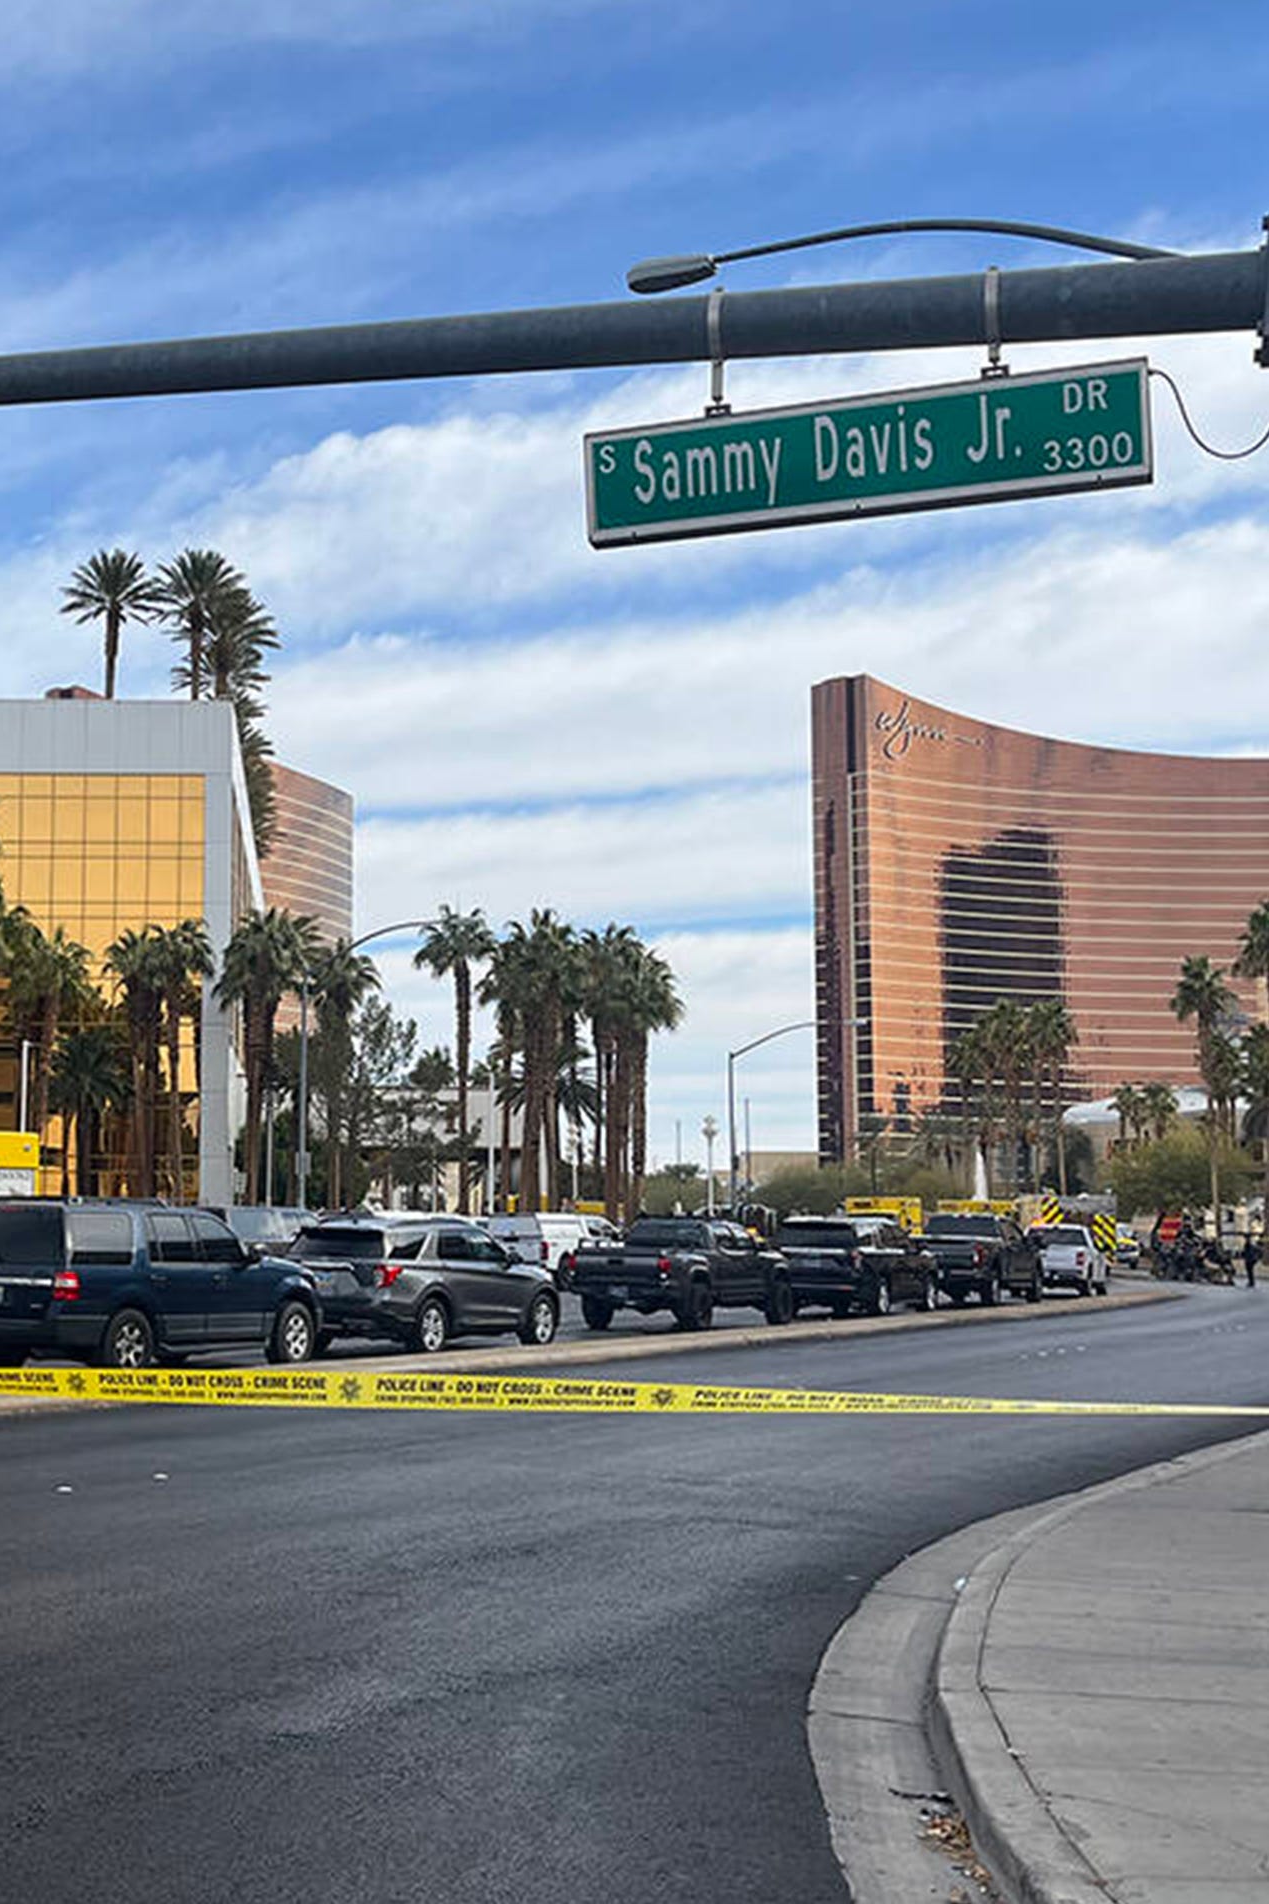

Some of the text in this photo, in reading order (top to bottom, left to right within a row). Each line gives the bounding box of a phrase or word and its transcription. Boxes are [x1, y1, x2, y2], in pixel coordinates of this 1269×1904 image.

[599, 379, 1108, 506] S Sammy Davis Jr. DR
[1042, 431, 1132, 473] 3300
[99, 1374, 133, 1385] POLICE
[169, 1375, 183, 1387] DO
[186, 1375, 206, 1387] NOT
[208, 1376, 244, 1388] CROSS
[253, 1376, 288, 1389] CRIME
[291, 1377, 326, 1389] SCENE
[376, 1379, 636, 1396] POLICE LINE DO NOT CROSS CRIME SCENE
[694, 1390, 740, 1400] POLICE
